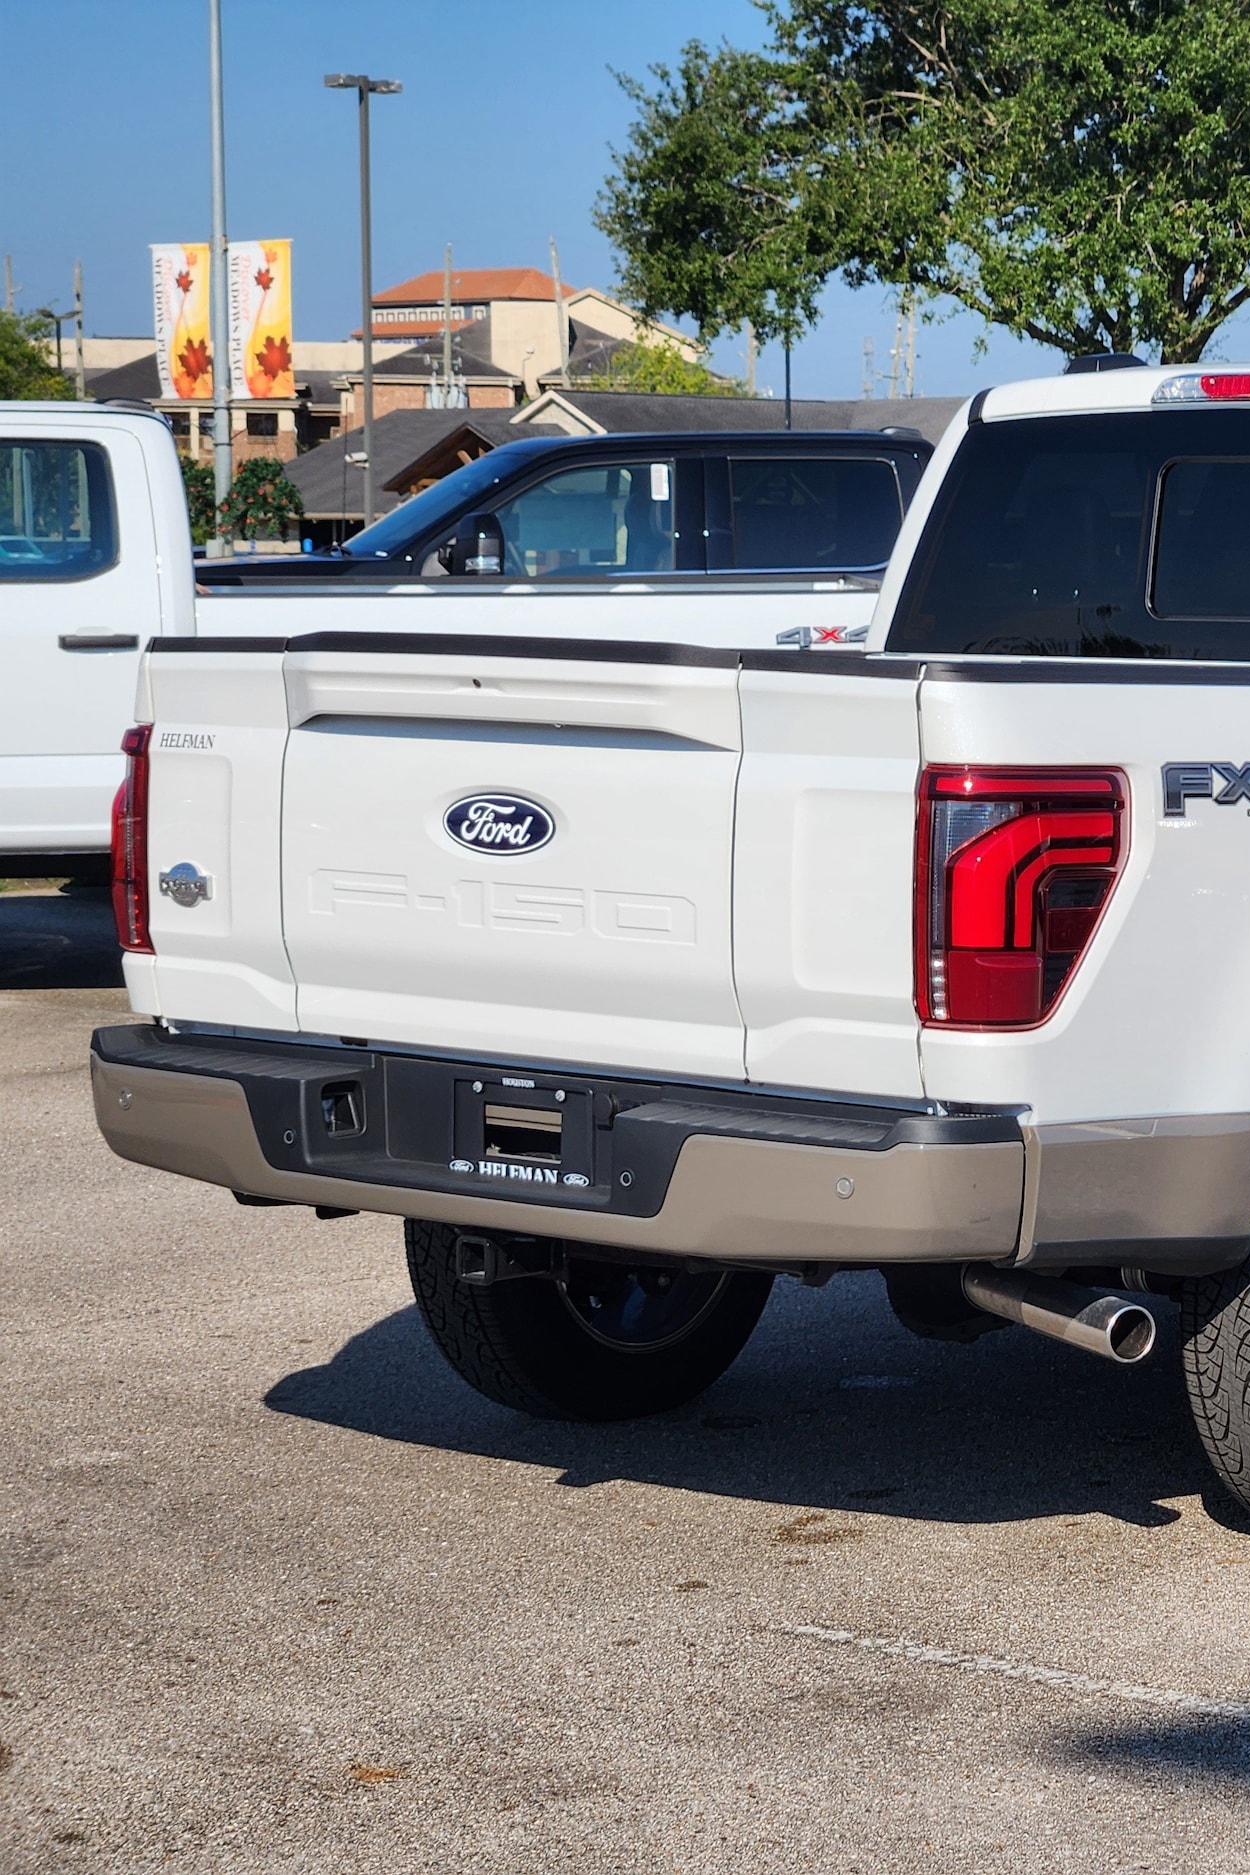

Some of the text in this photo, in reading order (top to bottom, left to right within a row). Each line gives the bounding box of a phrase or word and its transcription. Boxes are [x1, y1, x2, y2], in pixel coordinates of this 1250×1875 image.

[154, 258, 171, 386] MEADOWS PLACE
[231, 256, 244, 386] MEADOWS PLACE
[160, 732, 217, 749] HELFMAN
[461, 801, 535, 845] Ford
[307, 868, 698, 946] F-150
[478, 1160, 559, 1184] HELFMAN
